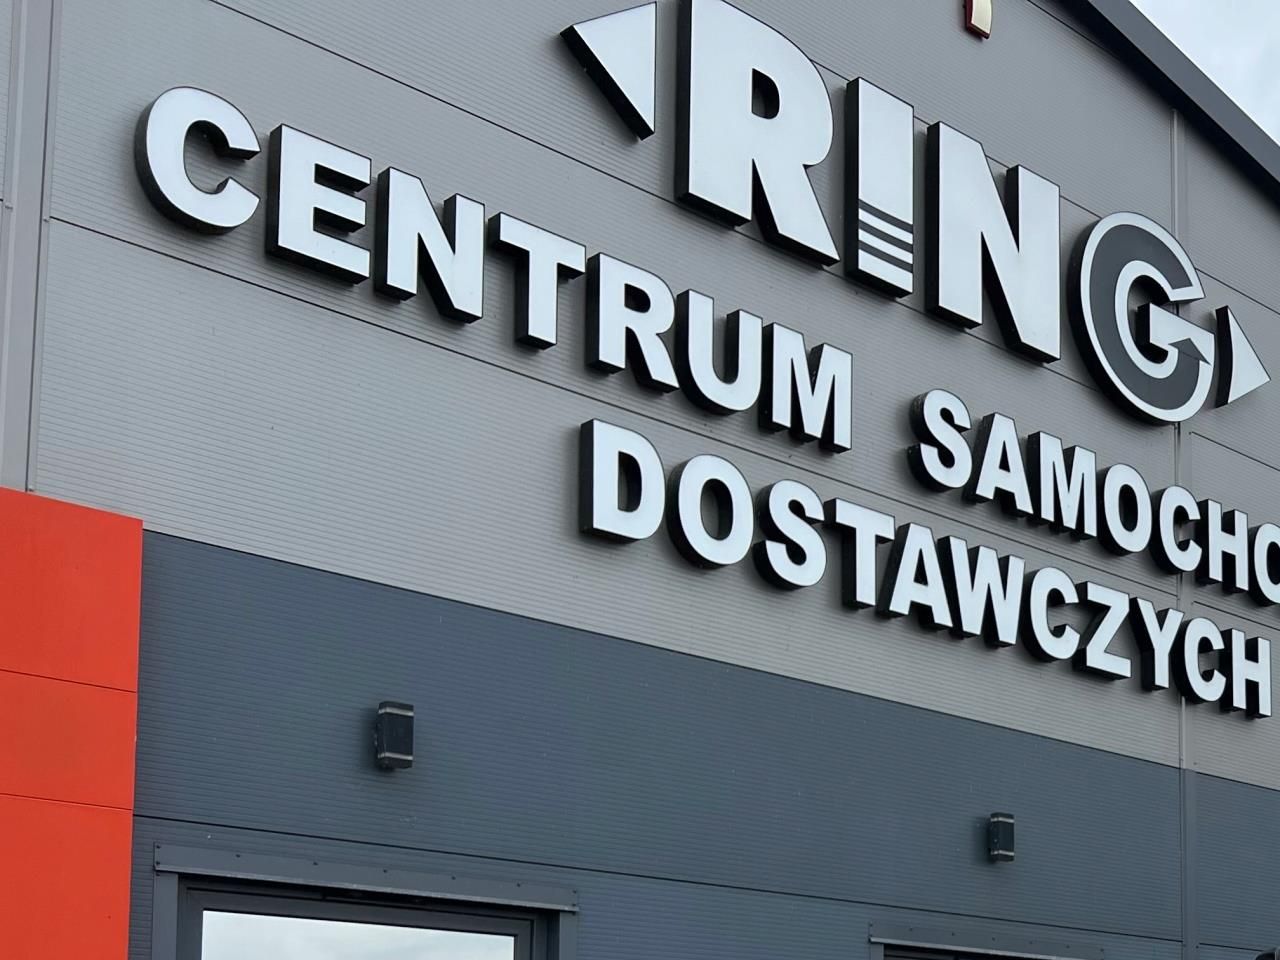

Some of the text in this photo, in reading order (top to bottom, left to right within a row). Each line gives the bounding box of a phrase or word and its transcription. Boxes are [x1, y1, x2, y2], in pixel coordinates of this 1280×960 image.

[136, 86, 853, 454] CENTRUM
[677, 0, 1216, 425] RING
[580, 418, 1273, 720] DOSTAWCZYCH
